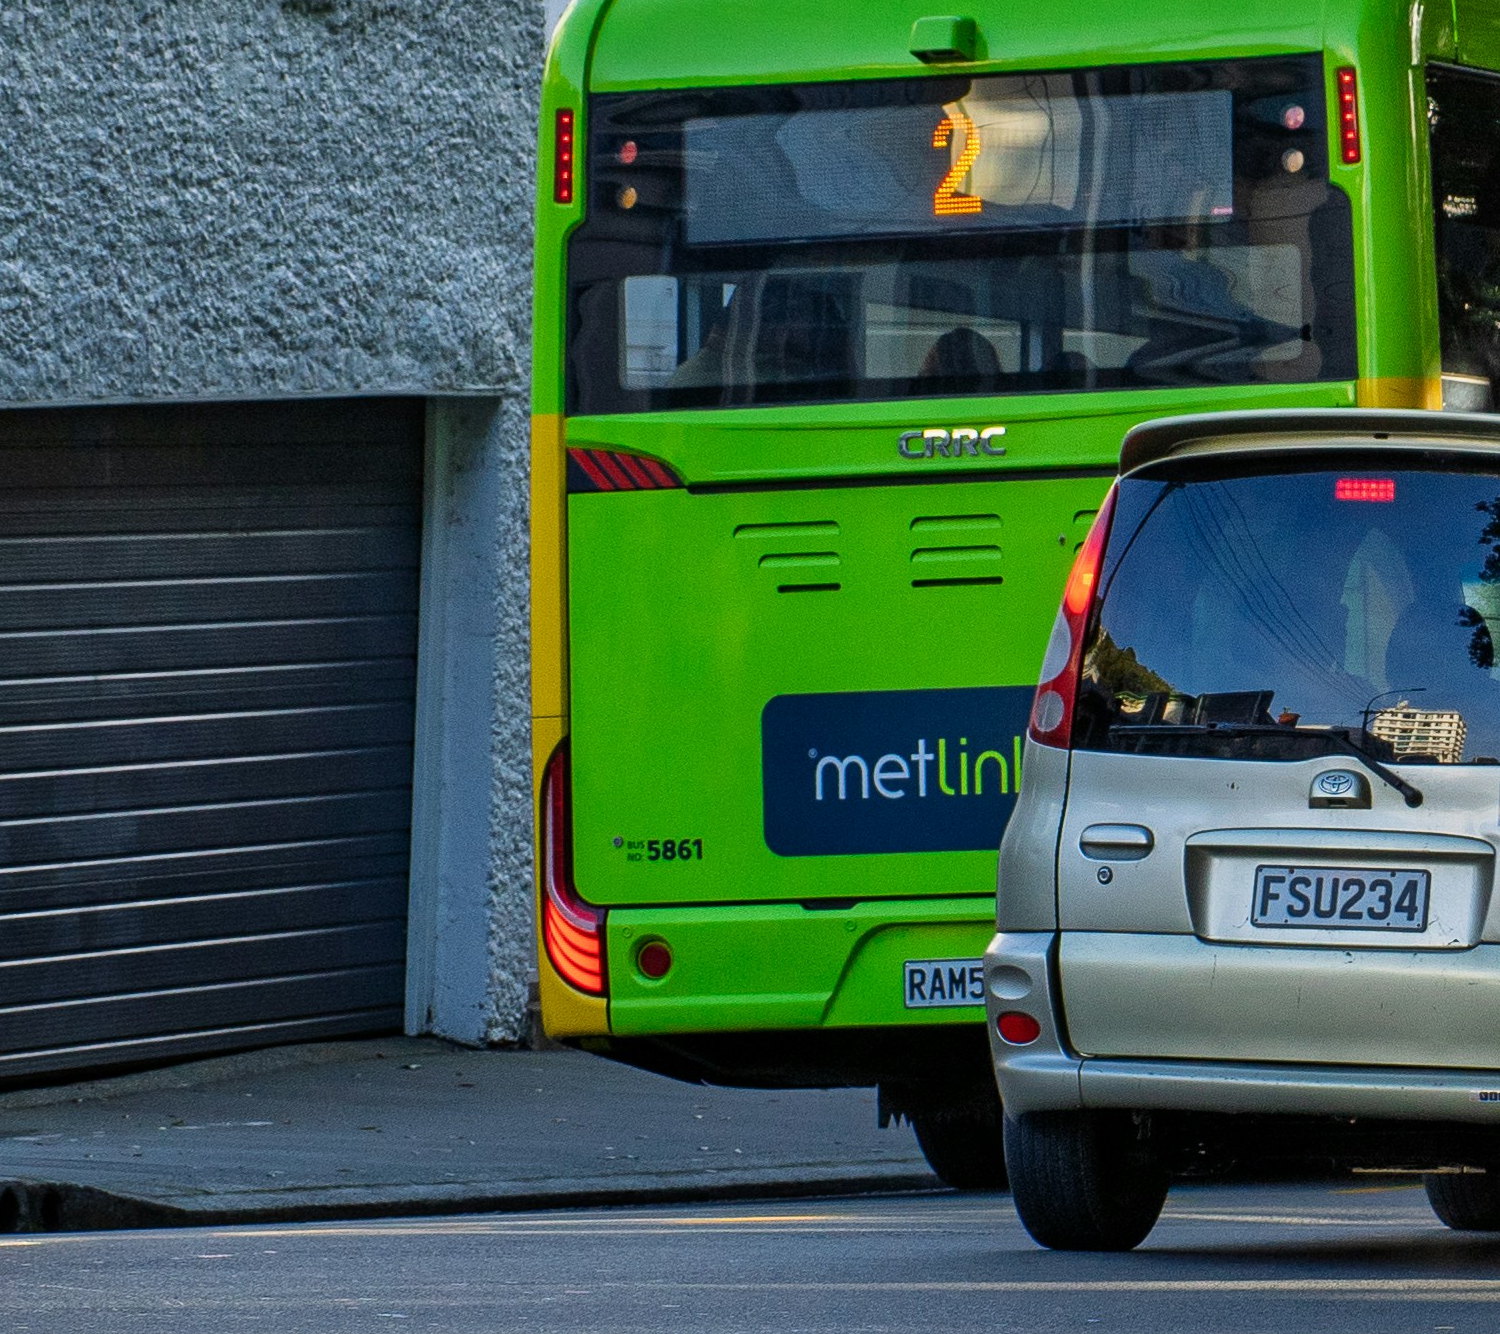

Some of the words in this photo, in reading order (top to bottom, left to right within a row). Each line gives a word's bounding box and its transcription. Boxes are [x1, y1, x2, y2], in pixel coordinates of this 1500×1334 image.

[932, 113, 982, 215] 2
[898, 426, 1006, 459] CRRC
[627, 841, 645, 849] BUS
[647, 839, 703, 861] 5861
[1260, 876, 1418, 921] FSU234
